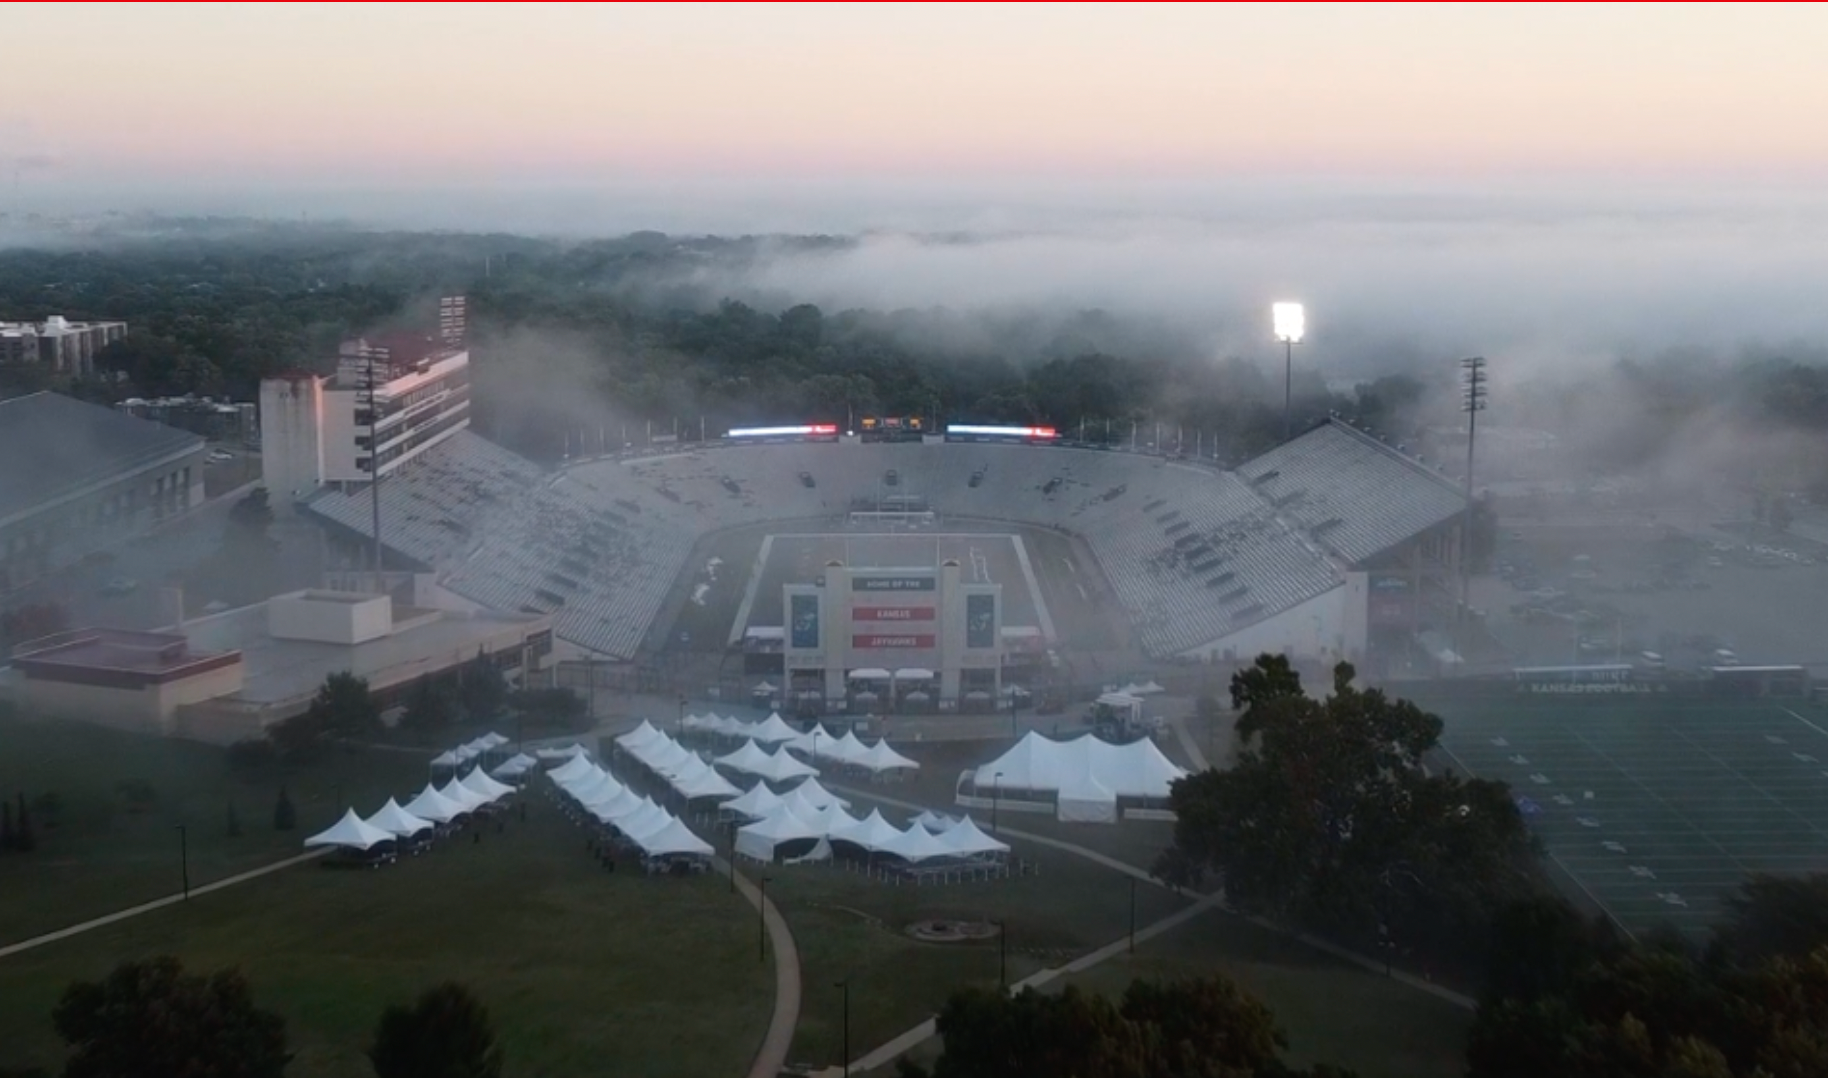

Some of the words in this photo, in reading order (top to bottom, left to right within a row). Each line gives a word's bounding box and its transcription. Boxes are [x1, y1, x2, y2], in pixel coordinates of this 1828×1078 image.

[877, 610, 911, 619] KANSAS
[871, 637, 917, 646] JAYHAWKS
[1531, 683, 1584, 693] KANSAS
[1585, 683, 1652, 693] FOOTBALL
